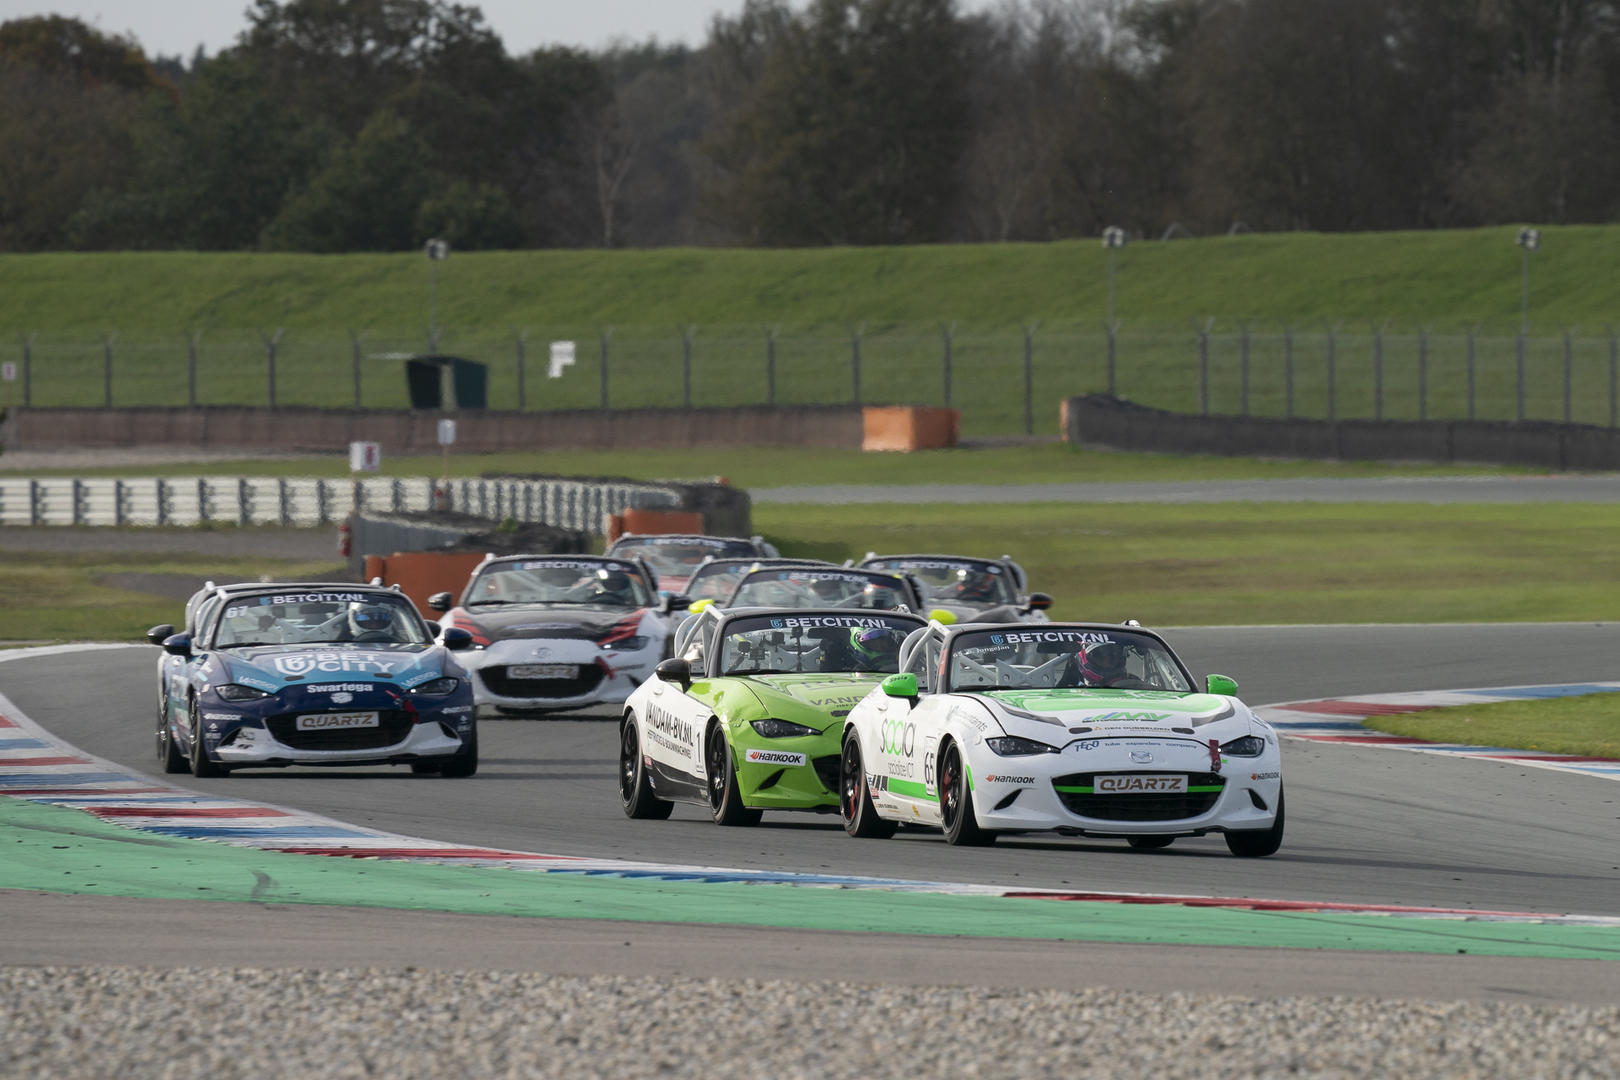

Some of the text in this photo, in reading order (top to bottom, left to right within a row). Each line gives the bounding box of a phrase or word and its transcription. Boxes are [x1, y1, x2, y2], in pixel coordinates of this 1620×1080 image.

[272, 593, 369, 604] BETCITY.NL
[225, 605, 249, 619] 67
[785, 617, 893, 629] BETCITY.NL
[1005, 632, 1116, 644] BETCITY.NL
[316, 653, 380, 661] BET
[317, 661, 396, 673] CITY
[306, 683, 374, 693] Swarfega
[302, 714, 374, 728] QUARTZ
[645, 700, 694, 747] VANDAM-BV.NL
[696, 731, 701, 763] 1
[1074, 740, 1100, 752] TECO
[924, 751, 935, 785] 65
[1099, 777, 1183, 792] QUARTZ
